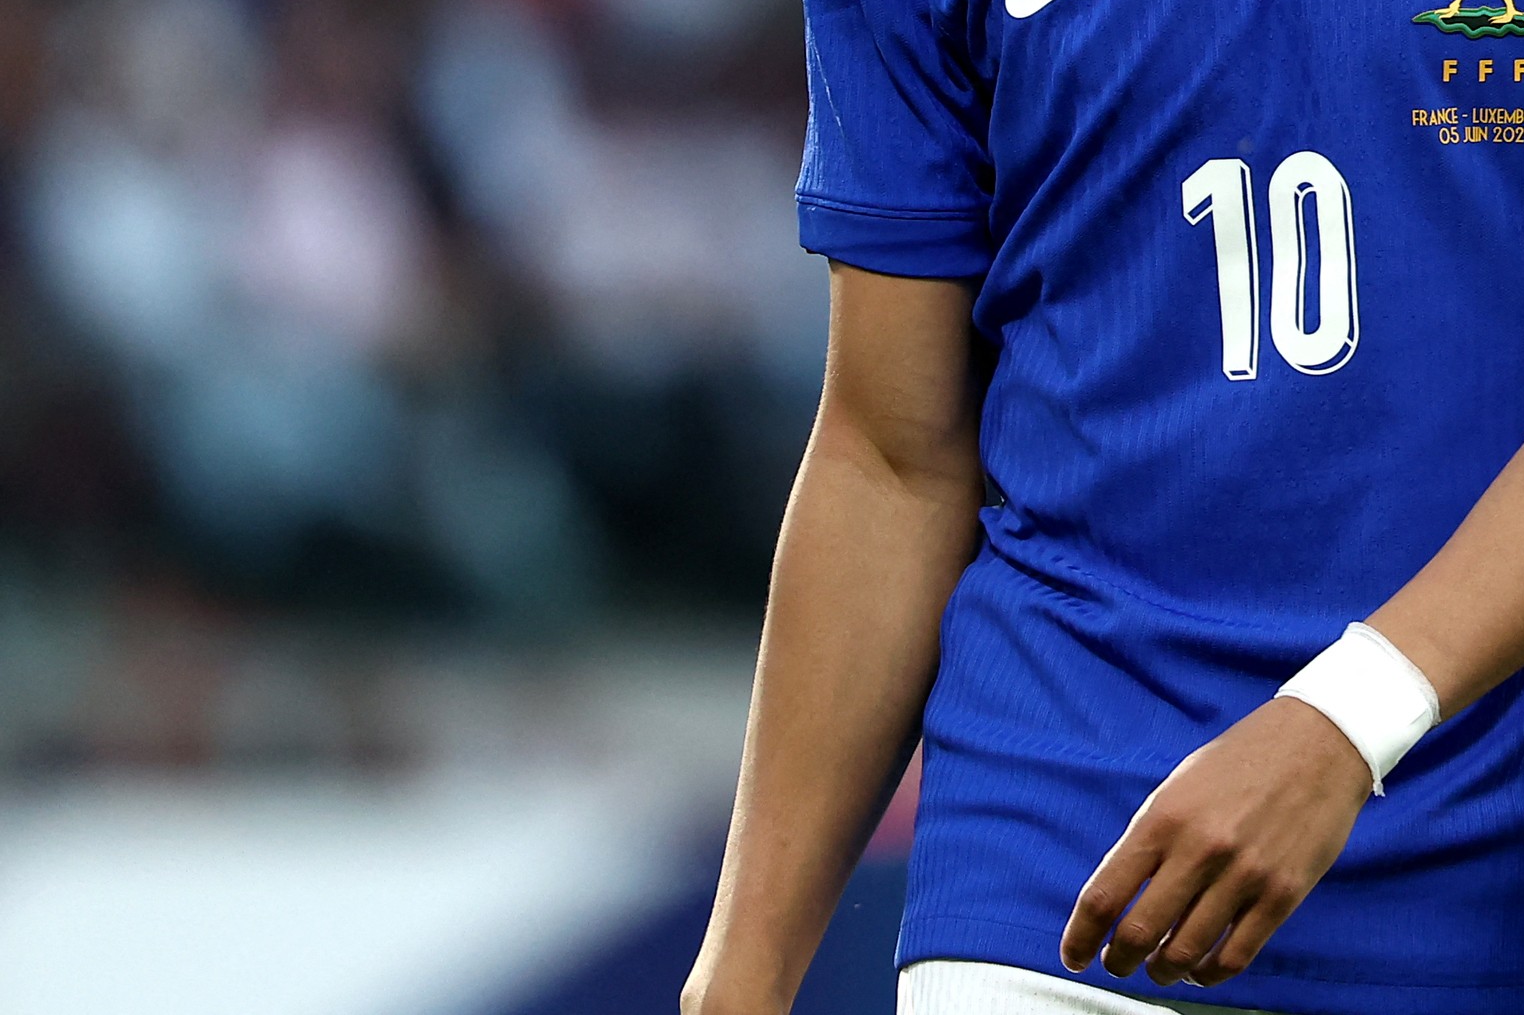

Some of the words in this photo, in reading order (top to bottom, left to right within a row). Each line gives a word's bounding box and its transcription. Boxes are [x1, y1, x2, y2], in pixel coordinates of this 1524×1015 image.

[1412, 107, 1459, 126] FRANCE
[1438, 126, 1460, 144] 05
[1462, 126, 1489, 143] JUIN
[1181, 150, 1360, 381] 10
